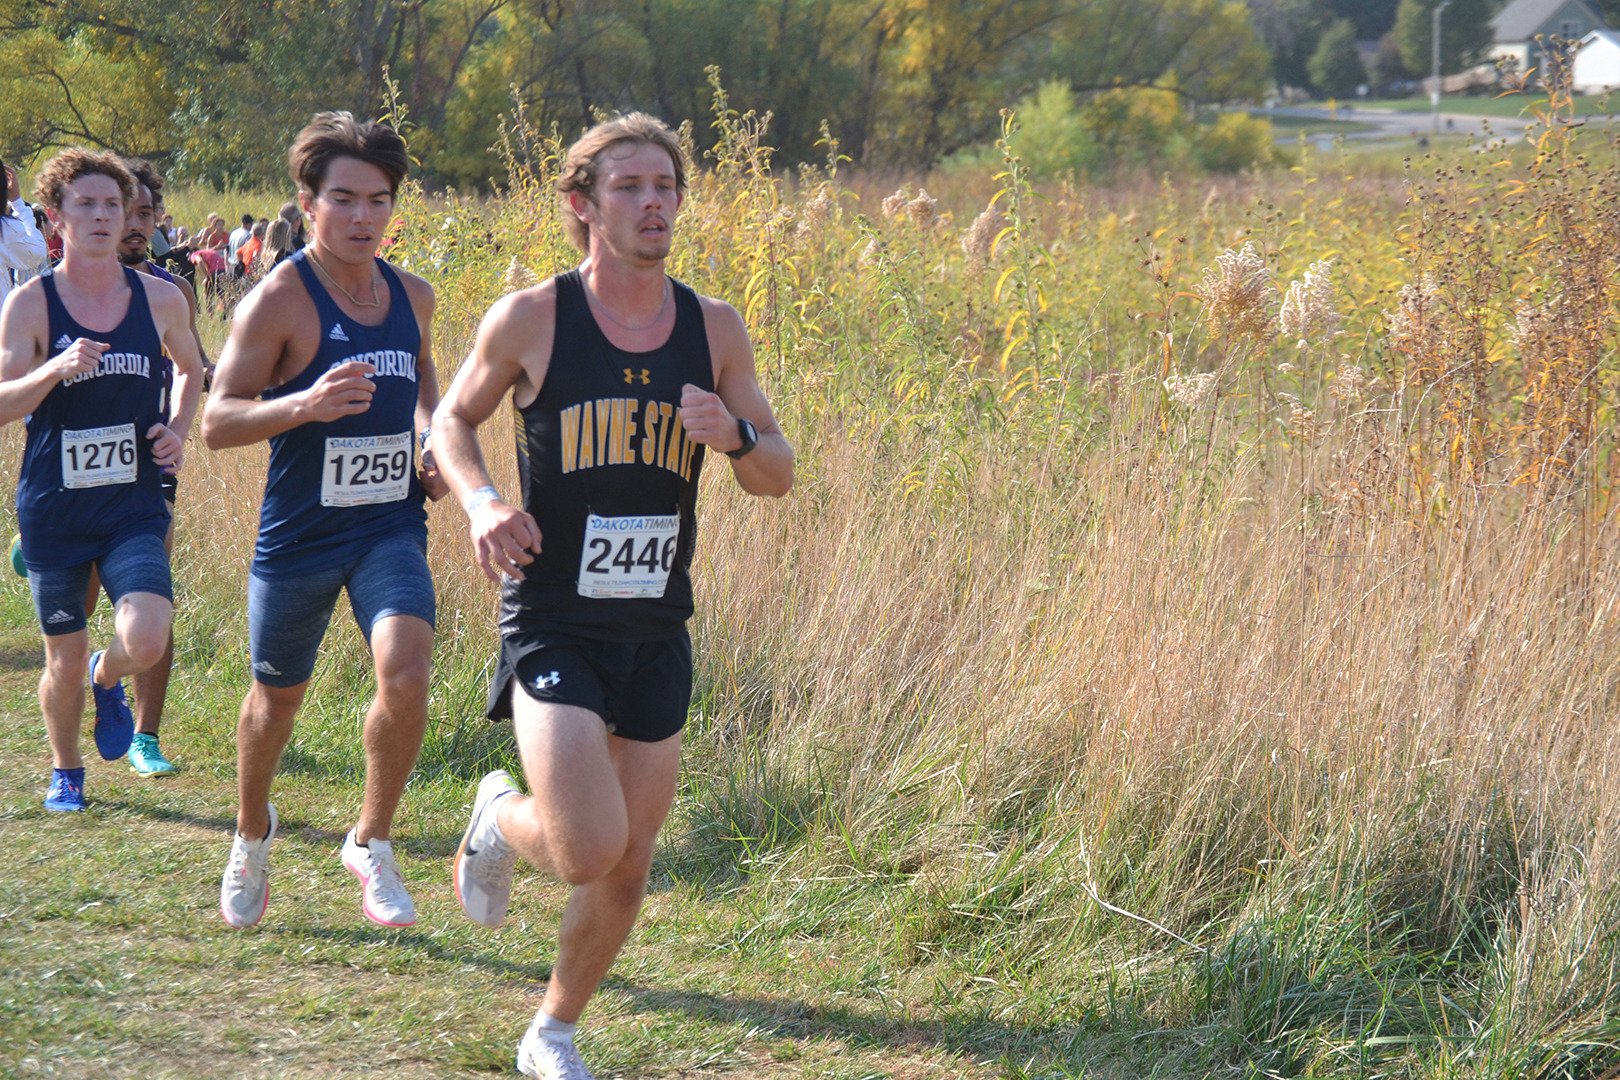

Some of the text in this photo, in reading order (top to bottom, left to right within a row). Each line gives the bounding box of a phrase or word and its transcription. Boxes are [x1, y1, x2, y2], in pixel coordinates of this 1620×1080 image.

[66, 425, 132, 439] DAKOTATIMING
[331, 433, 408, 448] DAKOTATIMING
[560, 398, 638, 474] WAYNE
[66, 439, 135, 471] 1276
[330, 450, 408, 486] 1259
[586, 535, 677, 574] 2446
